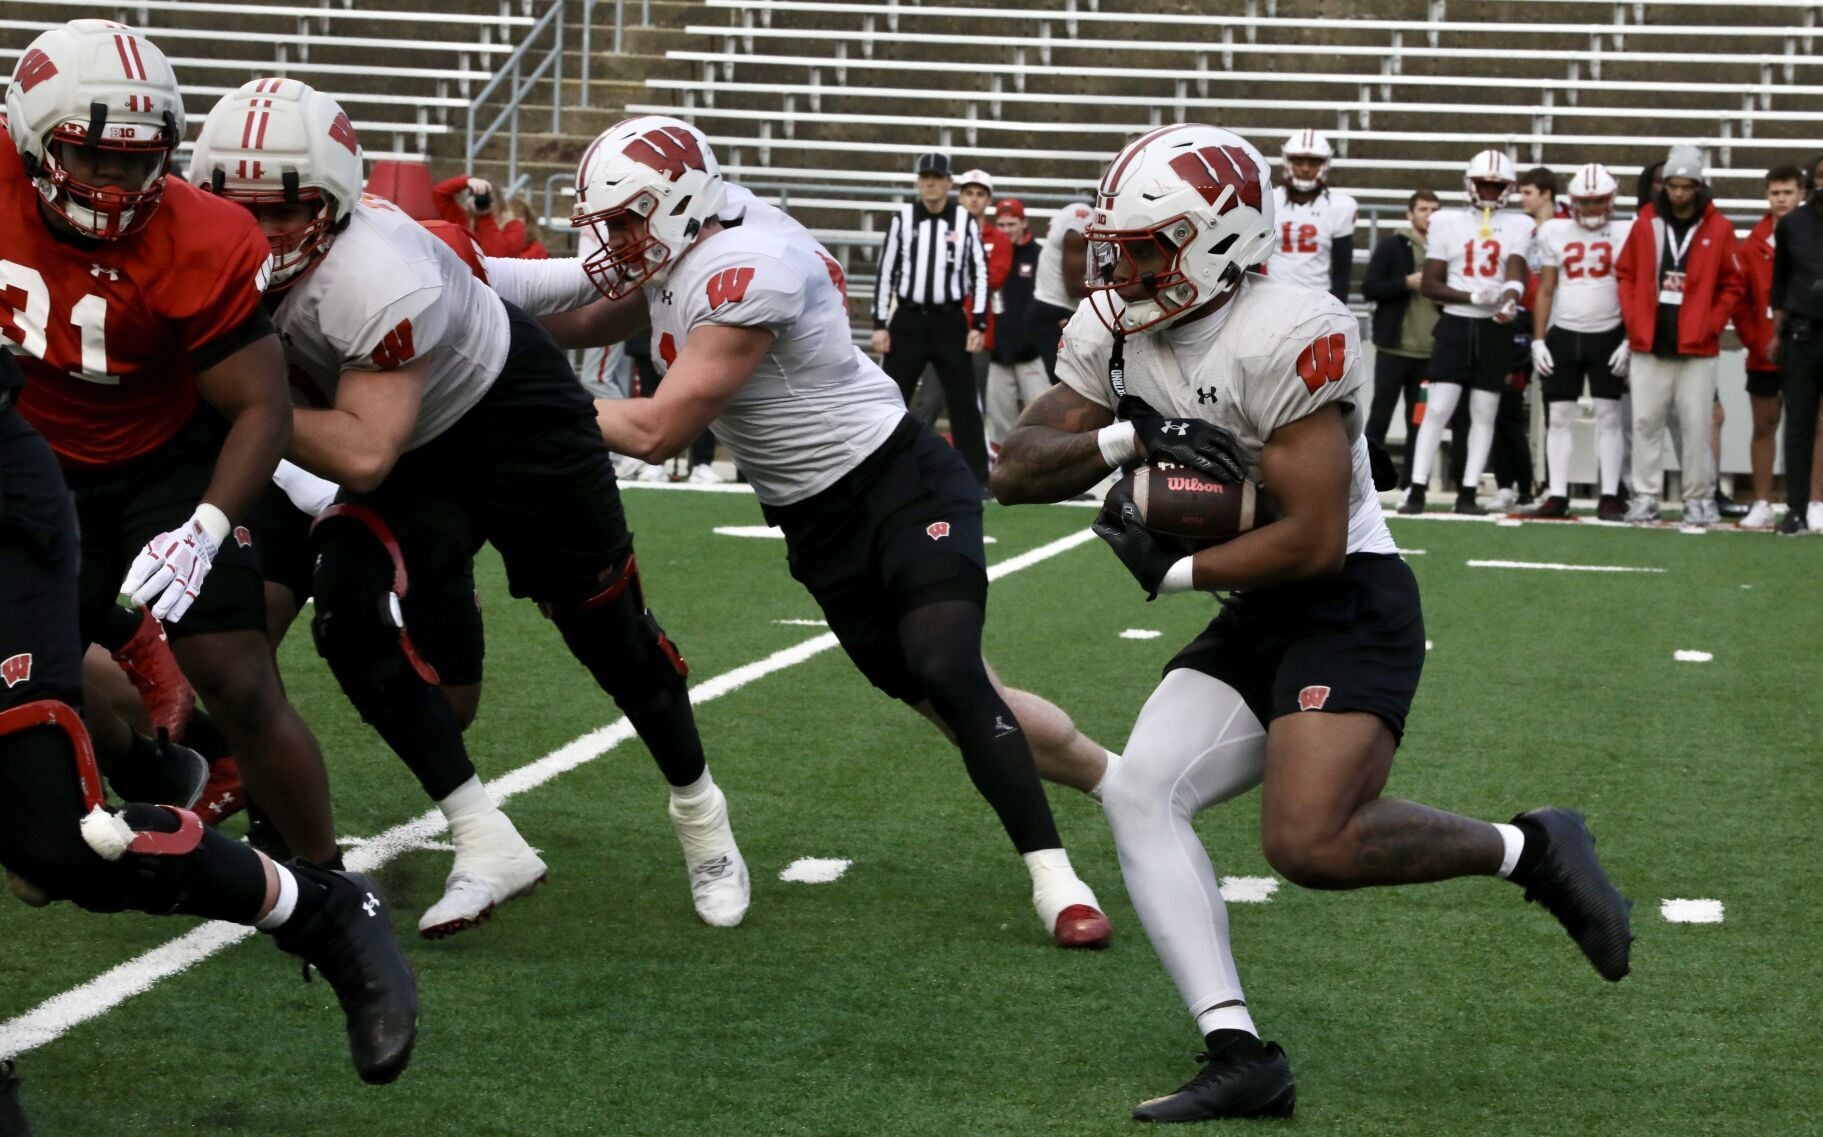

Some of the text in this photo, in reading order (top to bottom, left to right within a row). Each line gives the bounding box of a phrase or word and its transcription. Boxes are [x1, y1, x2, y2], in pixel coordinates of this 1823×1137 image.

[15, 48, 59, 94] W
[328, 112, 358, 156] W
[621, 126, 708, 182] W
[1168, 144, 1262, 216] W
[1281, 221, 1318, 253] 12
[1462, 239, 1501, 277] 13
[1563, 241, 1613, 279] 23
[706, 267, 755, 311] W
[0, 258, 120, 385] 31
[371, 318, 415, 371] W
[1296, 332, 1345, 397] W
[1167, 477, 1223, 494] Wilson
[0, 653, 32, 688] W
